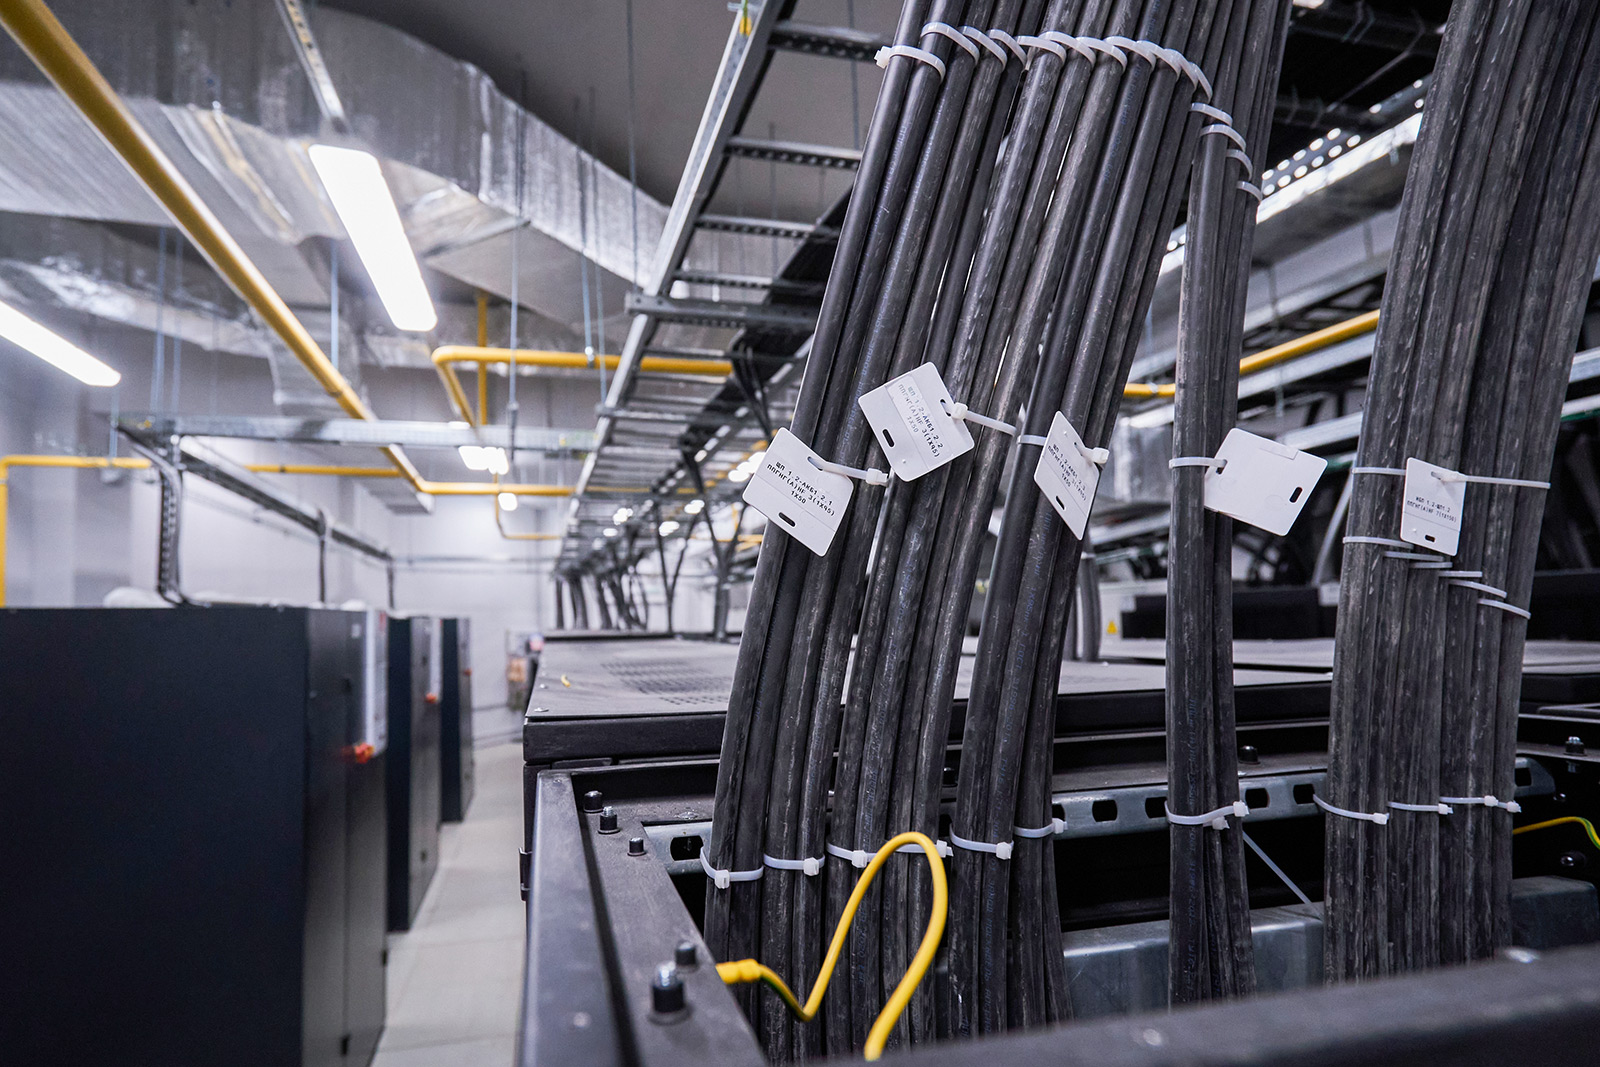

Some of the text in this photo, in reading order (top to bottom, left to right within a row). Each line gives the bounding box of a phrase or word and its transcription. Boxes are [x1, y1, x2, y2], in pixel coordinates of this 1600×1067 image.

[788, 471, 833, 506] 1.2-АКБ1.2.1
[791, 490, 807, 504] 1X50
[808, 494, 835, 517] 3(1X95)
